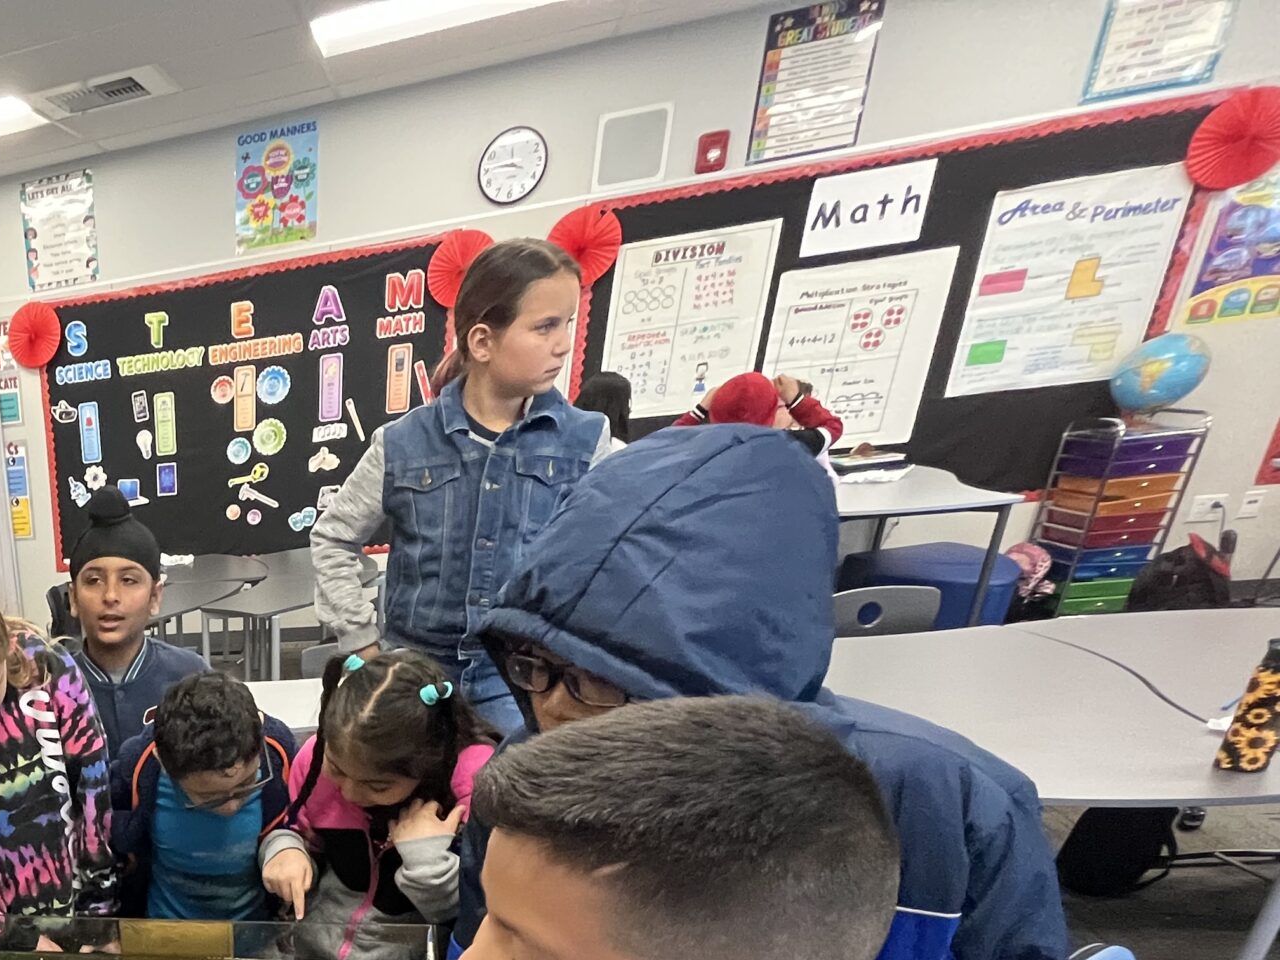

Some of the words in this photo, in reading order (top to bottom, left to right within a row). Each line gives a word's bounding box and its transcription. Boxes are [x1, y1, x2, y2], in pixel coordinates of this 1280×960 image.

[778, 26, 815, 46] GREAT
[237, 132, 267, 146] GOOD
[270, 121, 317, 141] MANNERS
[28, 188, 45, 200] LET'S
[46, 187, 58, 196] GET
[811, 185, 921, 231] Math
[998, 199, 1065, 226] Area
[1065, 202, 1088, 221] &
[1090, 197, 1182, 223] Perimeter
[655, 241, 726, 263] DIVISION
[66, 321, 87, 356] S
[145, 312, 169, 348] T
[231, 301, 254, 338] E
[313, 286, 345, 324] A
[385, 269, 425, 312] M
[376, 312, 425, 338] MATH
[209, 333, 303, 365] ENGINEERING
[308, 325, 350, 351] ARTS
[56, 360, 111, 385] SCIENCE
[117, 346, 205, 376] TECHNOLOGY
